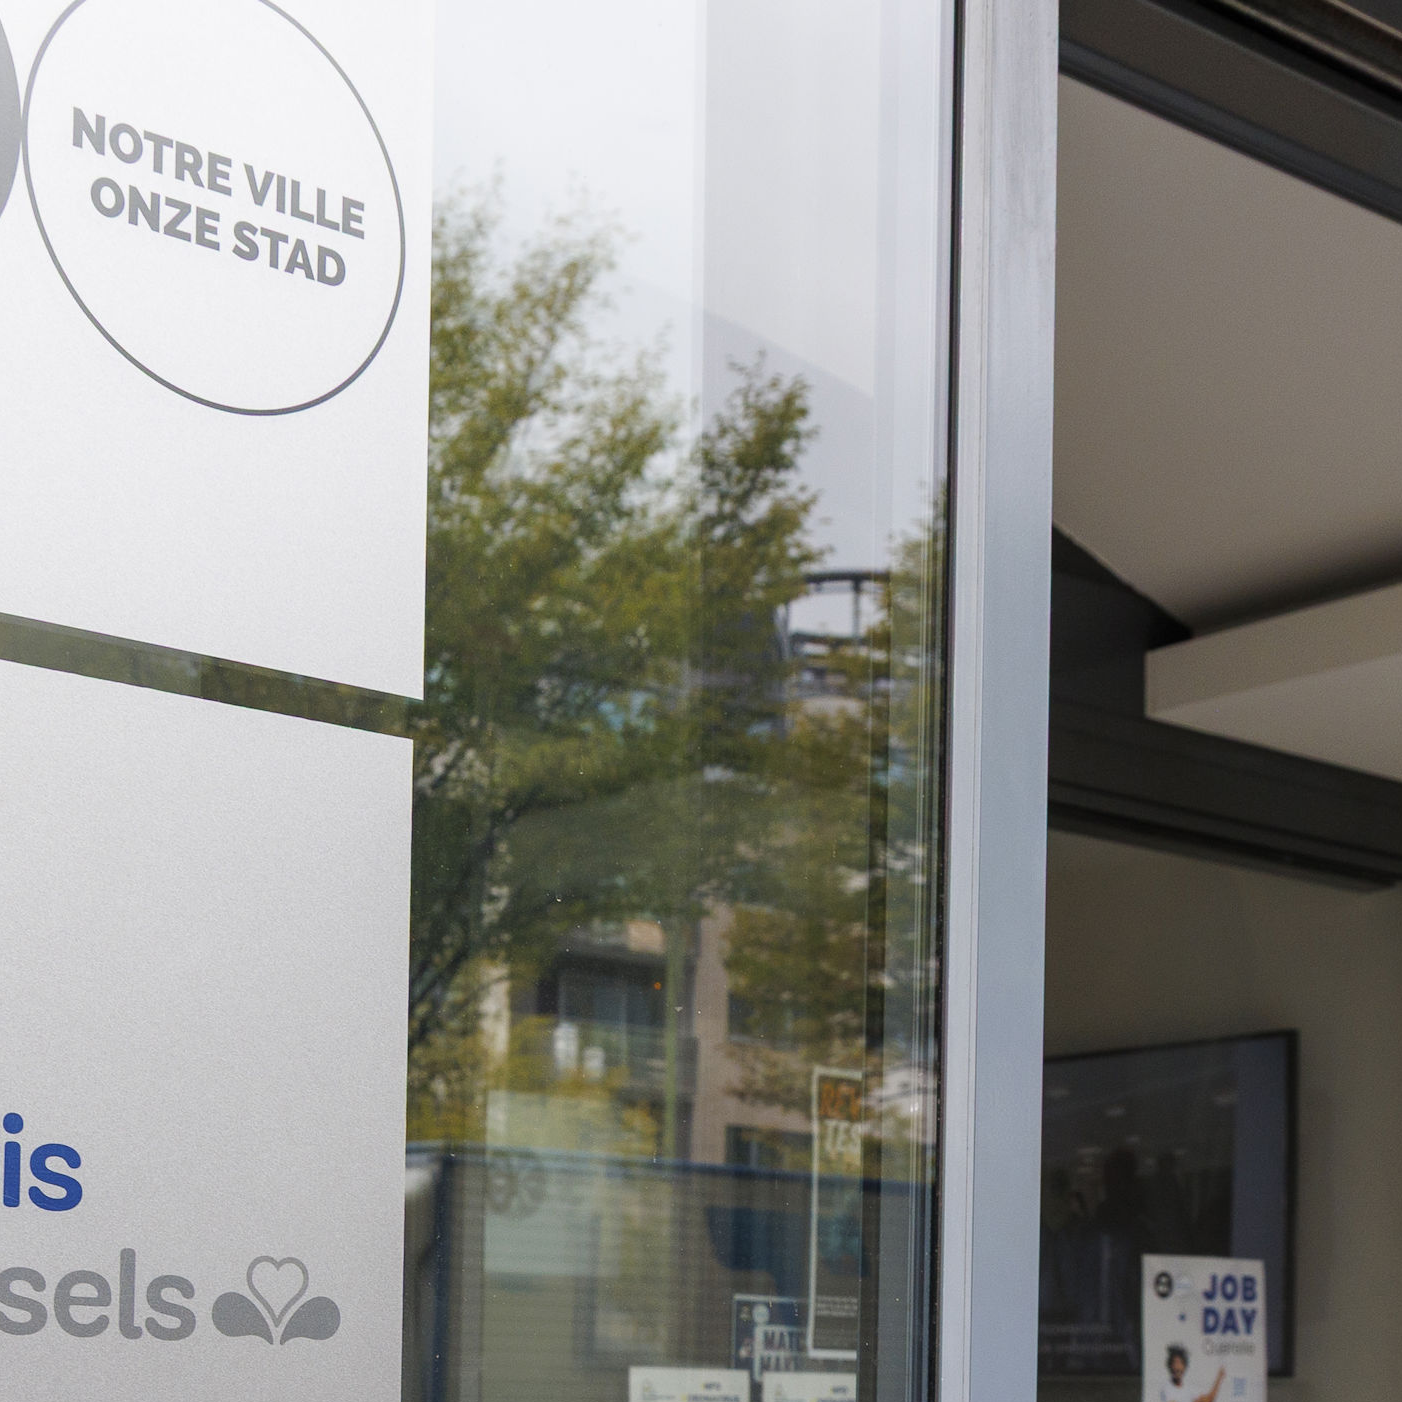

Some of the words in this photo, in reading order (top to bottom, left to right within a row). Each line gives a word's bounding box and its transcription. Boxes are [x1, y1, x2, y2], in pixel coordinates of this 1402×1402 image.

[71, 106, 234, 198] NOTRE
[243, 162, 366, 240] VILLE
[88, 176, 221, 253] ONZE
[231, 220, 347, 288] STAD
[1202, 1307, 1257, 1335] DAY
[1203, 1274, 1258, 1302] JOB
